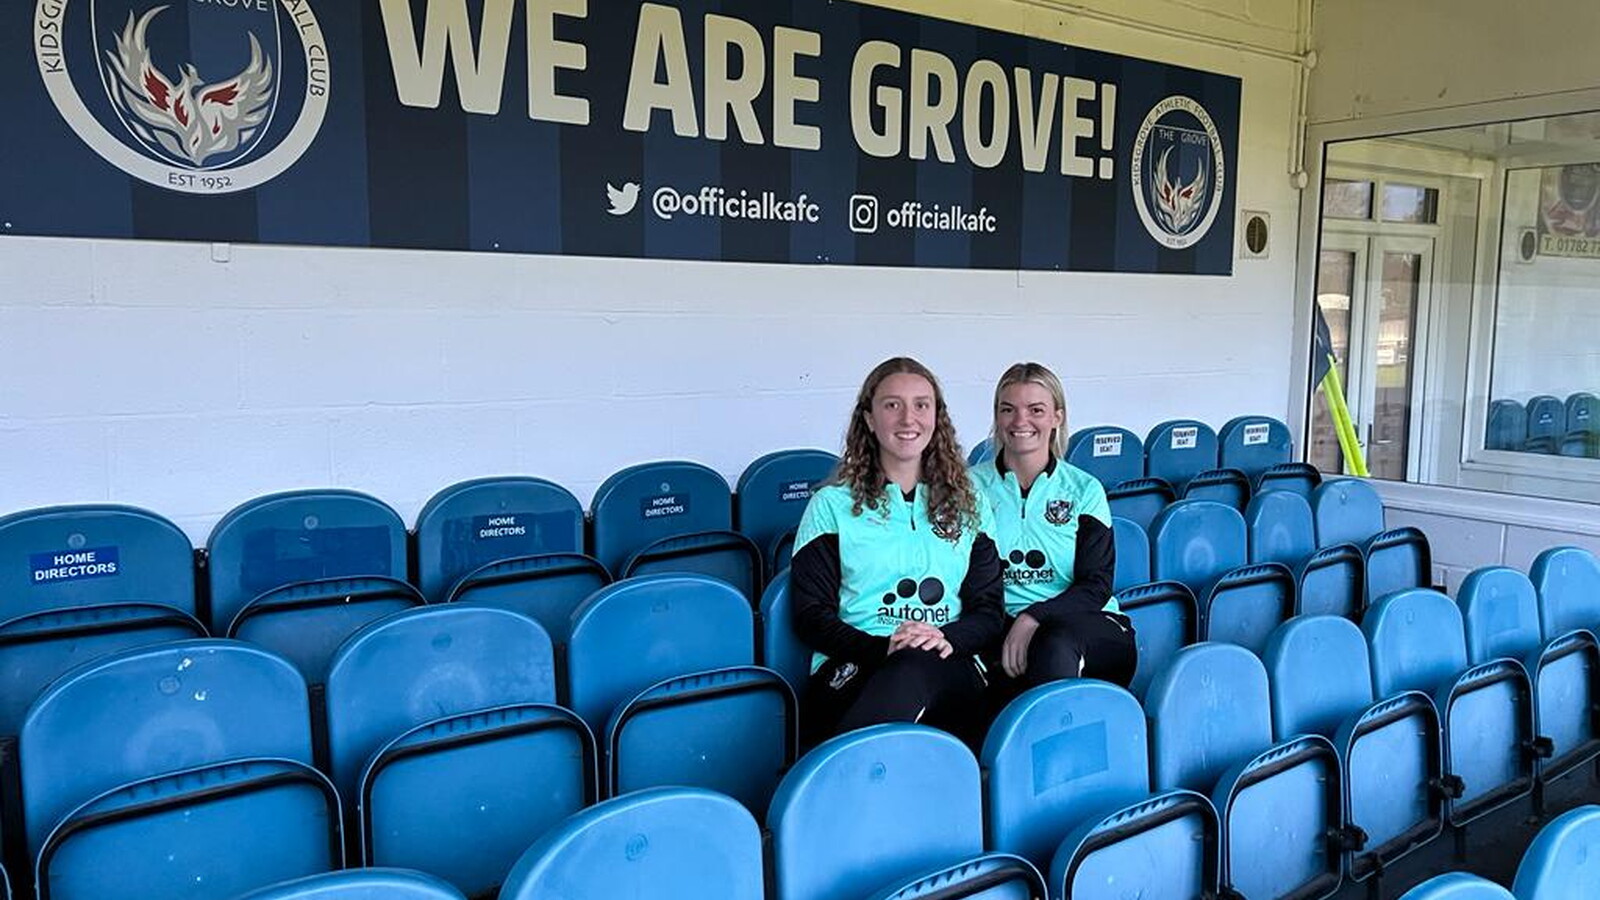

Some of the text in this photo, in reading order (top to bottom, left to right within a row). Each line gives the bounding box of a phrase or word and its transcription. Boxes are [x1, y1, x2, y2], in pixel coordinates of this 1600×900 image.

[40, 0, 63, 73] KIDSG
[308, 44, 326, 97] CLUB
[378, 0, 1117, 180] WE ARE GROVE!
[1159, 129, 1208, 146] THE GROVE
[168, 172, 233, 189] EST 1952
[652, 186, 820, 222] @officialkafc
[886, 202, 997, 233] officialkafc
[1557, 238, 1589, 253] 01782
[788, 482, 808, 490] HOME
[652, 496, 675, 506] HOME
[782, 491, 815, 500] DIRECTO
[645, 505, 684, 517] DIRECTORS
[488, 516, 515, 526] HOME
[480, 526, 526, 538] DIRECTORS
[54, 551, 96, 565] HOME
[34, 562, 117, 581] DIRECTORS
[877, 604, 950, 622] autonet
